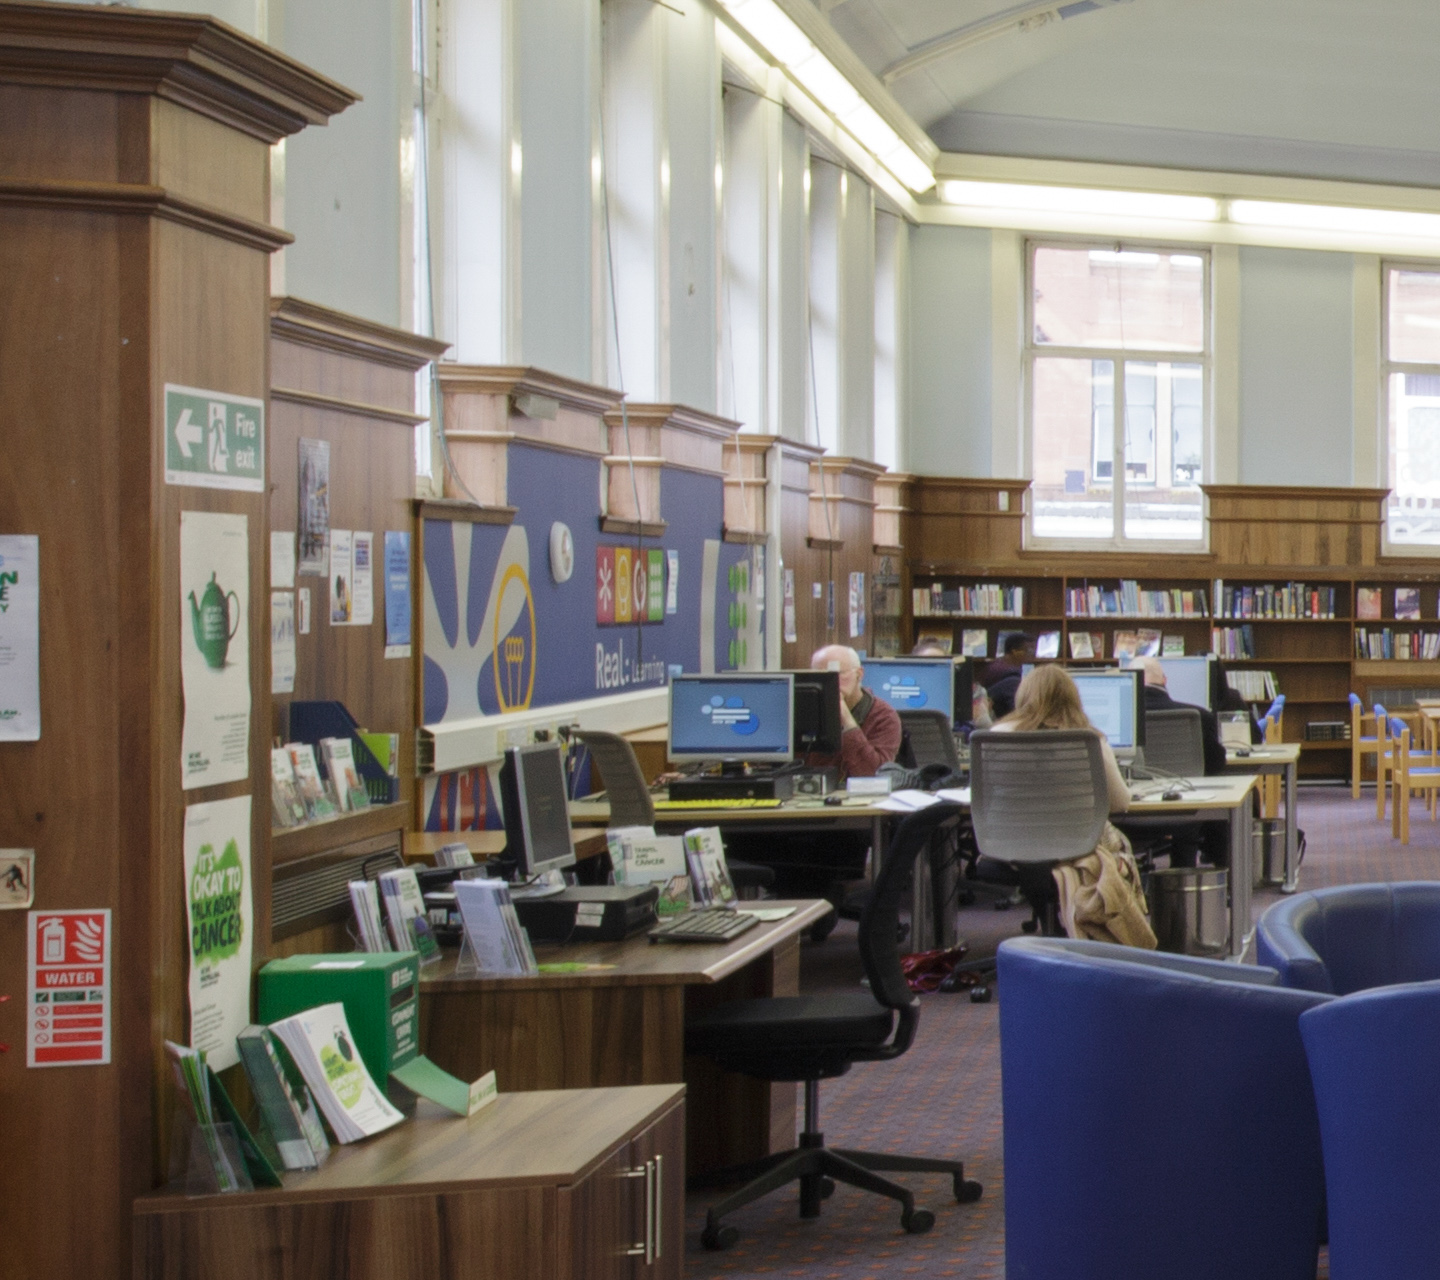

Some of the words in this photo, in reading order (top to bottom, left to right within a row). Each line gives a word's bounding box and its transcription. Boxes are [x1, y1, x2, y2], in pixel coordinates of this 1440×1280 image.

[236, 413, 256, 438] Fire
[236, 449, 256, 470] exit
[596, 638, 629, 689] Real:
[632, 656, 664, 684] Learning
[200, 853, 214, 870] IT'S
[635, 858, 665, 866] CANCER
[194, 871, 225, 899] OKAY
[228, 866, 241, 888] TO
[192, 896, 212, 920] TALK
[213, 892, 241, 914] ABOUT
[193, 916, 241, 956] CANCER
[46, 972, 95, 984] WATER
